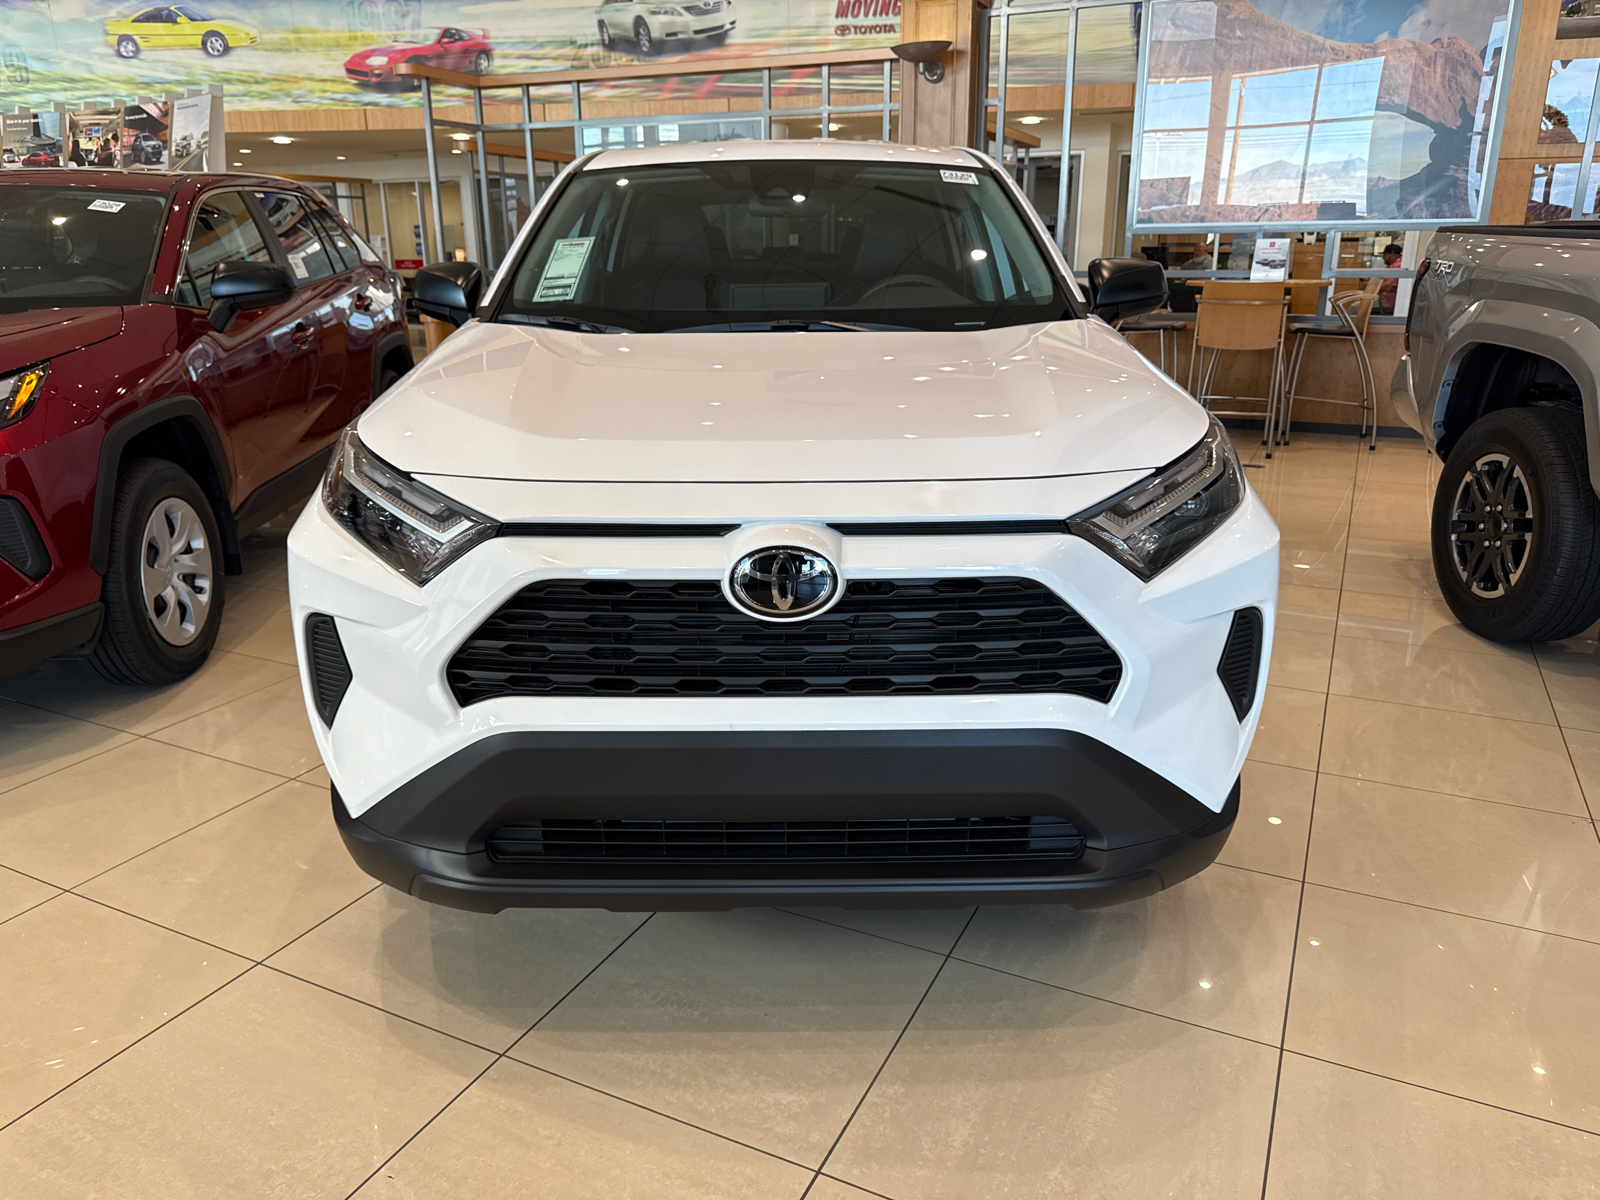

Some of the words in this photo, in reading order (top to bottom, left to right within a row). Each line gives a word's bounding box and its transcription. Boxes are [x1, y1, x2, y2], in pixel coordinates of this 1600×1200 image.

[835, 0, 901, 19] MOVING
[852, 24, 896, 35] TOYOTA
[1435, 259, 1454, 275] TRD
